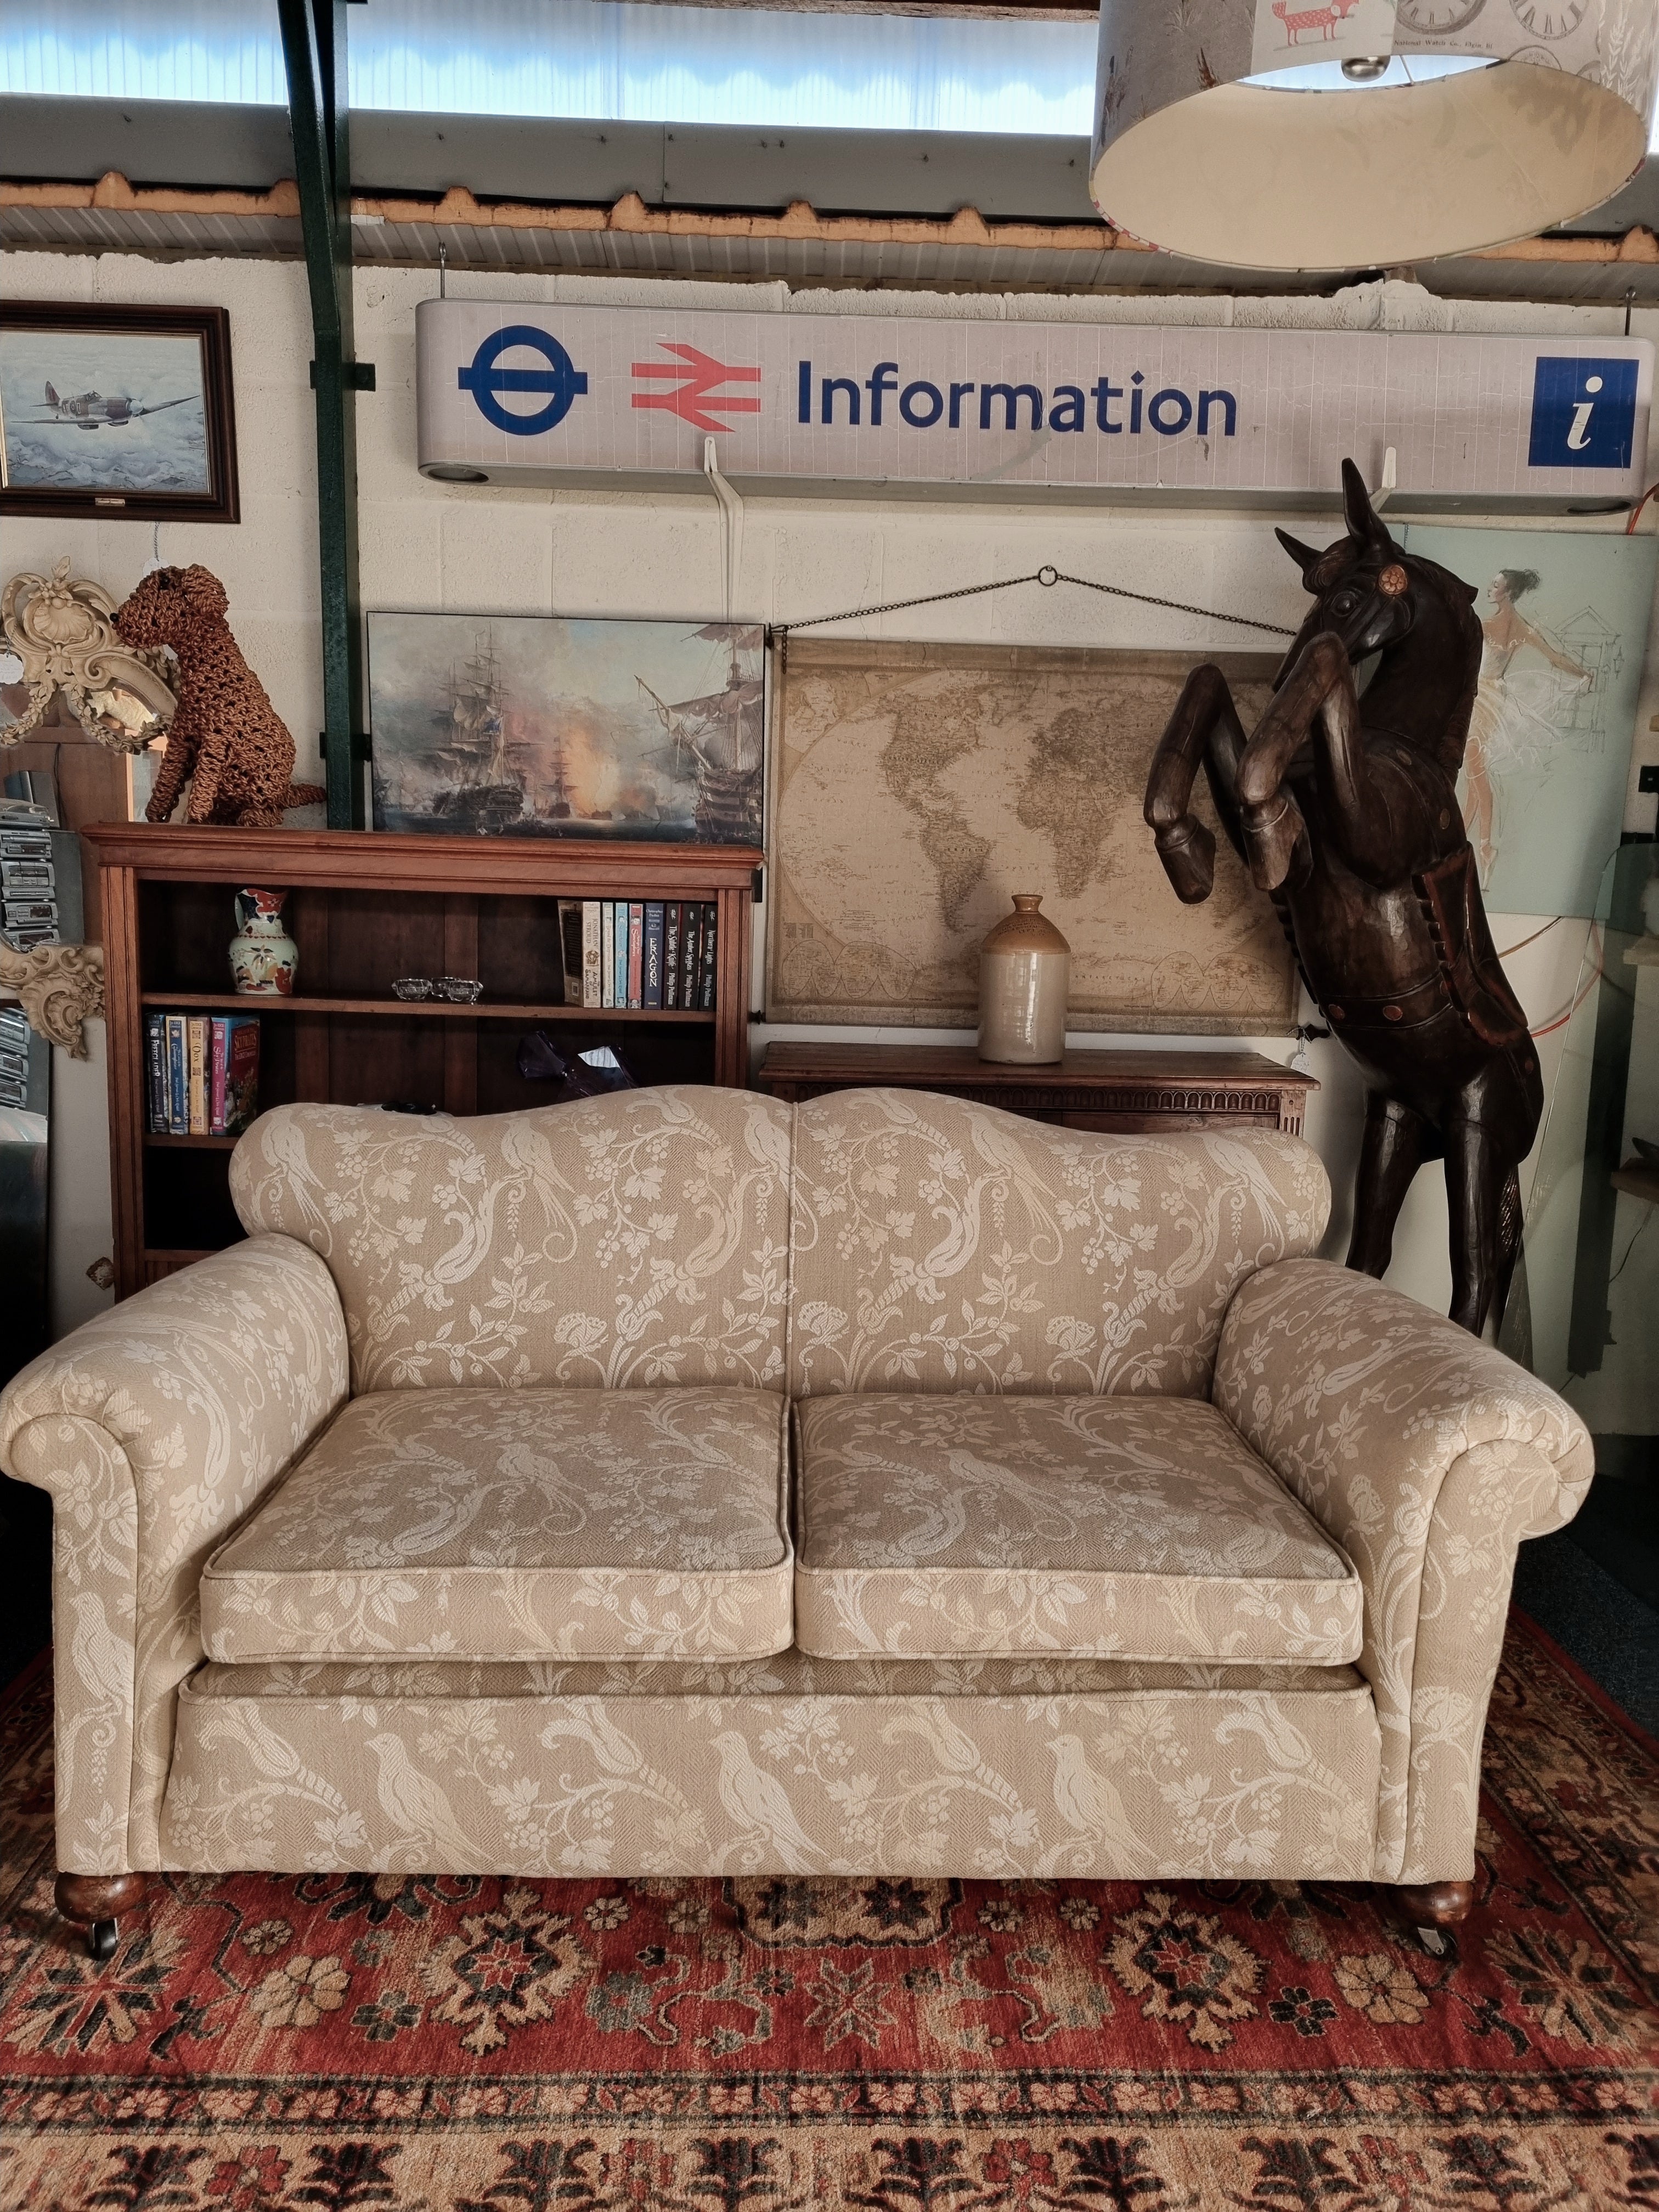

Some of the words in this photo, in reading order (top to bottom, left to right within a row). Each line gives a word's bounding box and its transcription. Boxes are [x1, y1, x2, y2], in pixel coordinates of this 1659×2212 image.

[798, 360, 1237, 437] Information
[1567, 376, 1604, 450] i
[648, 938, 658, 987] ERAGON
[667, 973, 675, 986] Philip
[684, 974, 693, 988] Philip
[704, 974, 713, 988] Philip
